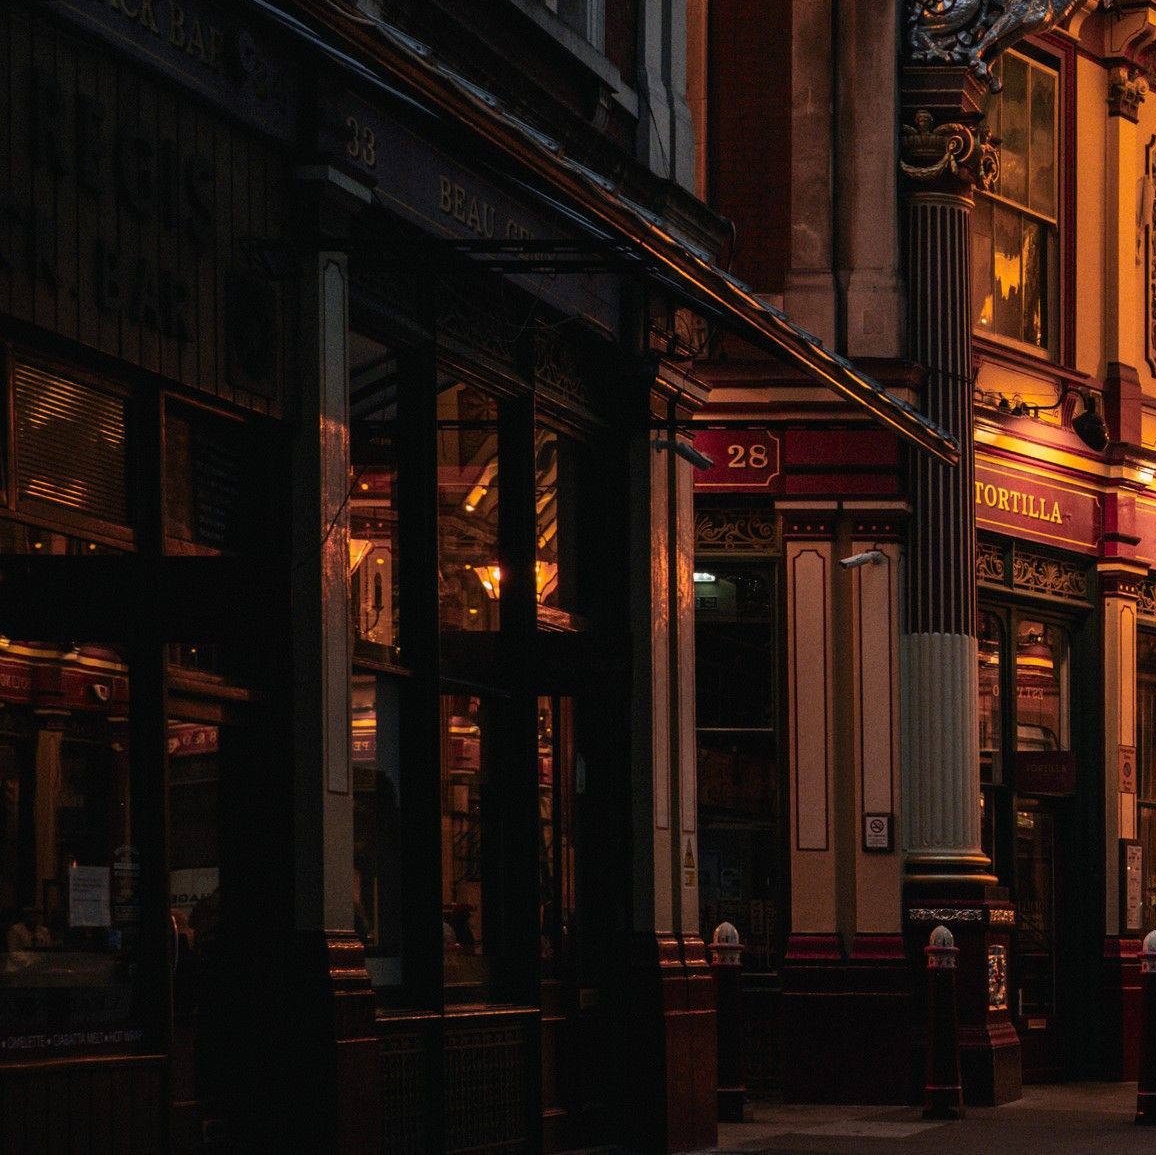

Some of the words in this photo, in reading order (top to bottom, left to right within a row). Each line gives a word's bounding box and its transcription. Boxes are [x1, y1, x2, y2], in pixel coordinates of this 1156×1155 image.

[346, 115, 375, 166] 33
[440, 174, 495, 240] BEAU
[727, 444, 768, 468] 28
[975, 480, 1063, 524] TORTILLA
